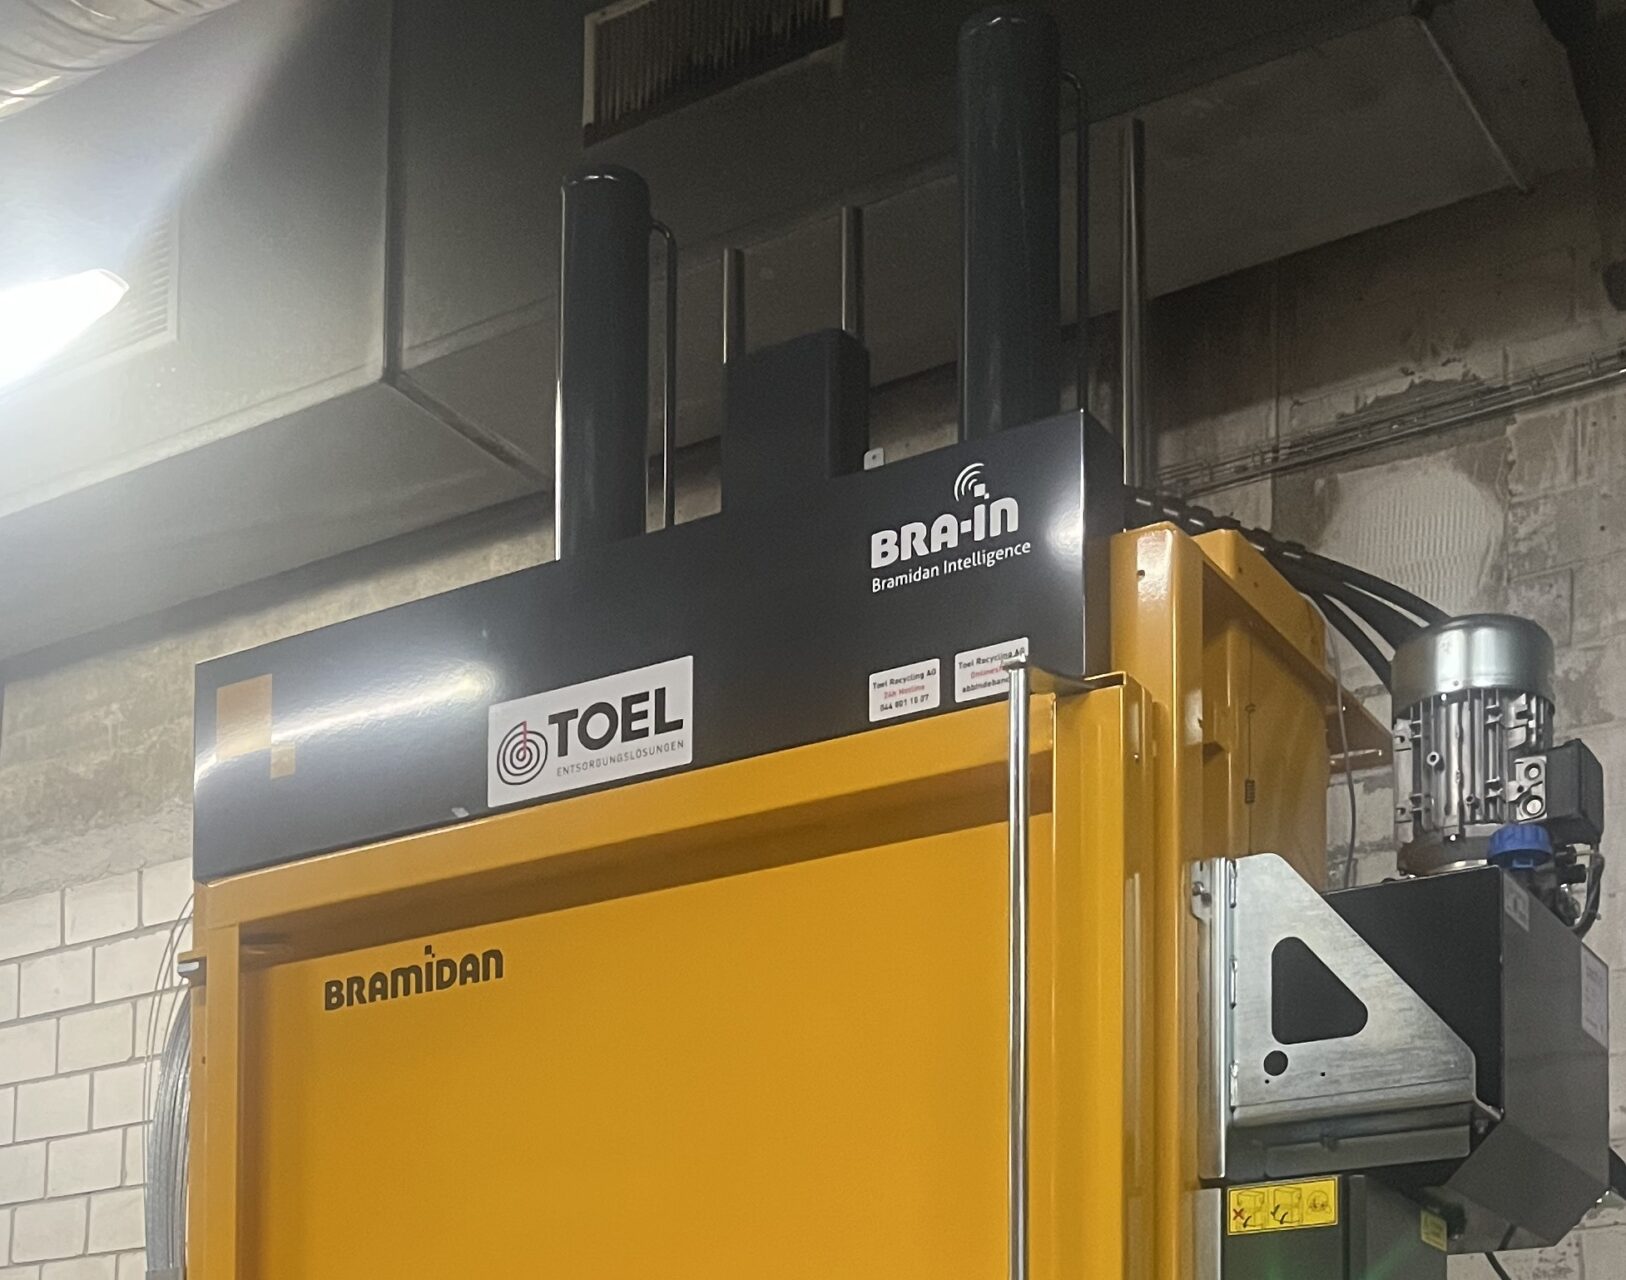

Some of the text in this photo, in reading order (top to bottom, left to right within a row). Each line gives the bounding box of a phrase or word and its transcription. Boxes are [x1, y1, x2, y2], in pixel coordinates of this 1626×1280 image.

[872, 541, 1031, 593] Bramidan Intelligence
[889, 672, 924, 685] Recycling
[926, 668, 937, 676] AG
[548, 686, 684, 758] TOEL
[556, 739, 684, 777] ENTSORGUNGSLÖSUNGEN
